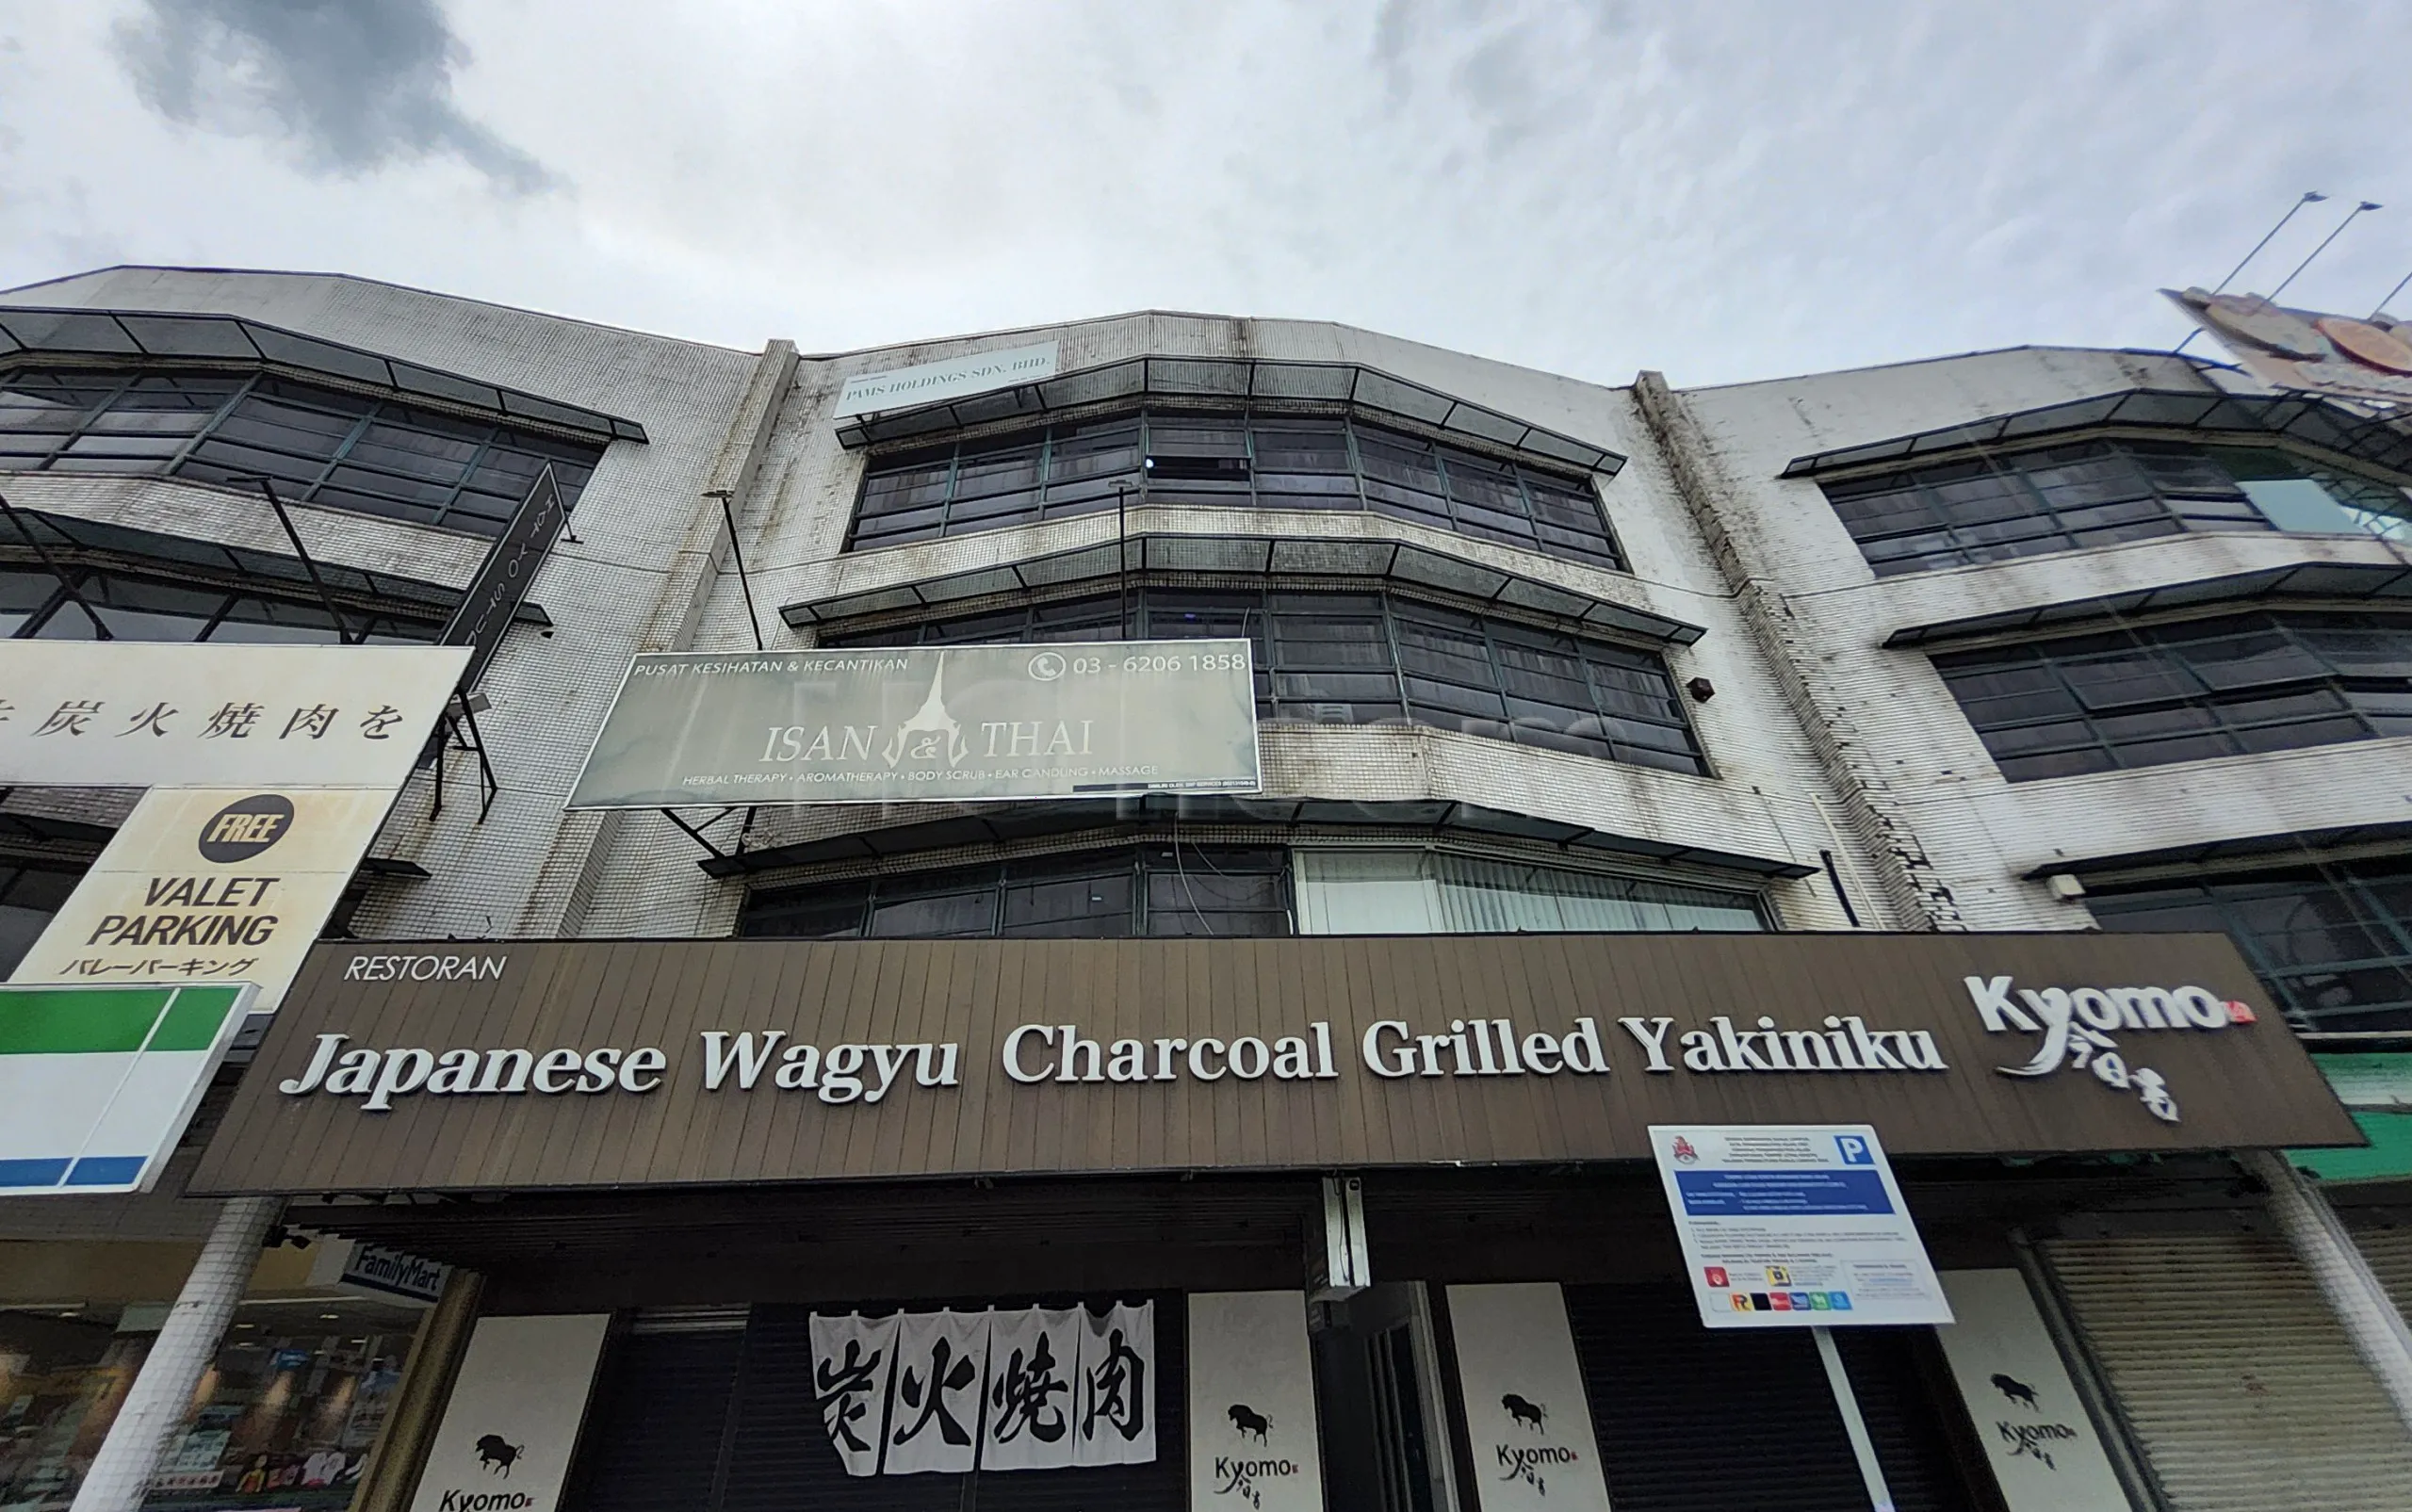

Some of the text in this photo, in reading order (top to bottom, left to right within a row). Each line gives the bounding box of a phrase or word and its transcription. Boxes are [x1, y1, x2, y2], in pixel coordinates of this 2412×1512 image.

[889, 372, 967, 393] HOLDINGS
[971, 364, 1007, 379] SDN.
[1012, 357, 1051, 371] BHD.
[633, 658, 909, 676] PUSAT KESIHATAN & KECANTIKAN
[1073, 657, 1101, 675] 03
[1123, 655, 1182, 673] 6206
[1190, 653, 1247, 672] 1858
[758, 724, 878, 762] ISAN
[981, 720, 1094, 758] THAI
[682, 773, 729, 786] HERBAL
[733, 772, 788, 784] THERAPY
[798, 771, 898, 783] AROMATHERAPY
[907, 771, 943, 781] BODY
[945, 770, 985, 780] SCRUB
[995, 769, 1019, 779] EAR
[1098, 765, 1158, 777] MASSAGE
[206, 813, 285, 843] FREE
[144, 877, 281, 907] VALET
[85, 915, 279, 946] PARKING
[344, 955, 508, 982] RESTORAN
[1964, 976, 2230, 1076] Kyomo
[279, 1015, 1949, 1111] Japanese Wagyu Charcoal Grilled Yakiniku
[355, 1244, 441, 1292] FamilyMart
[1996, 1421, 2067, 1455] Kyomo
[1214, 1456, 1291, 1495] Kyomo
[1496, 1444, 1571, 1480] Kyomo
[439, 1488, 526, 1512] Kyomo
